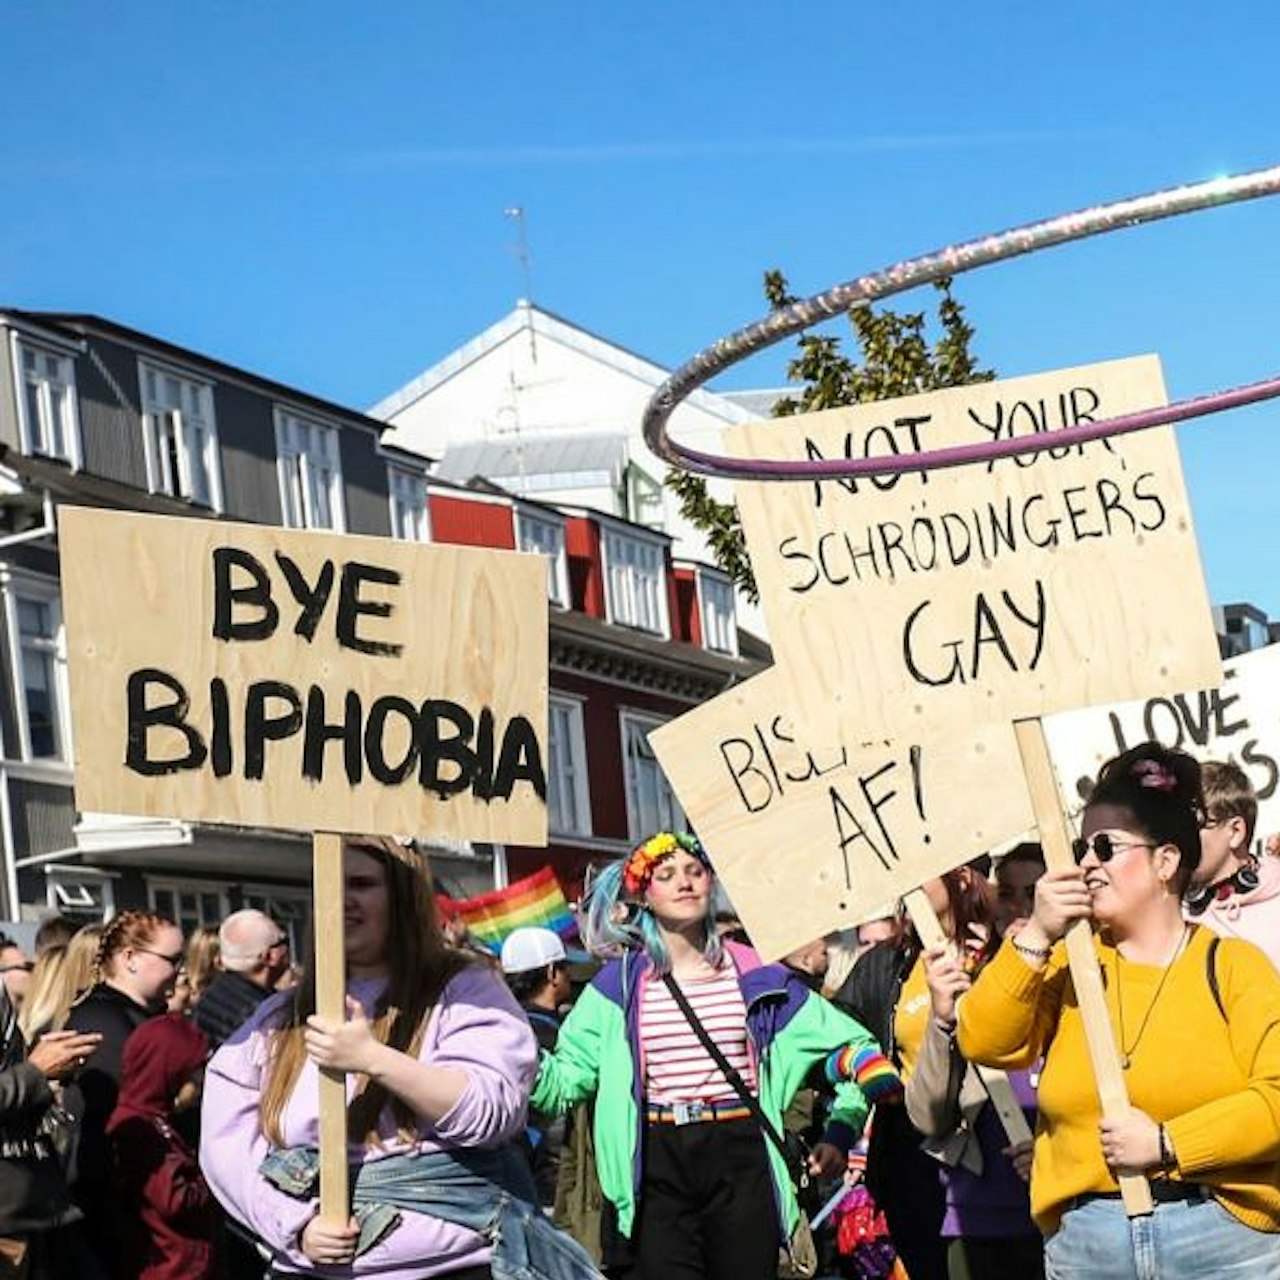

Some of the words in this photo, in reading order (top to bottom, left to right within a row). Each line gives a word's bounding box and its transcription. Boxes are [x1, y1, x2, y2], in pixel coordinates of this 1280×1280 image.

[805, 416, 932, 507] NOT
[968, 387, 1117, 473] YOUR
[211, 546, 404, 658] BYE
[902, 579, 1046, 687] GAY
[123, 667, 549, 804] BIPHOBIA
[828, 745, 931, 890] AF!
